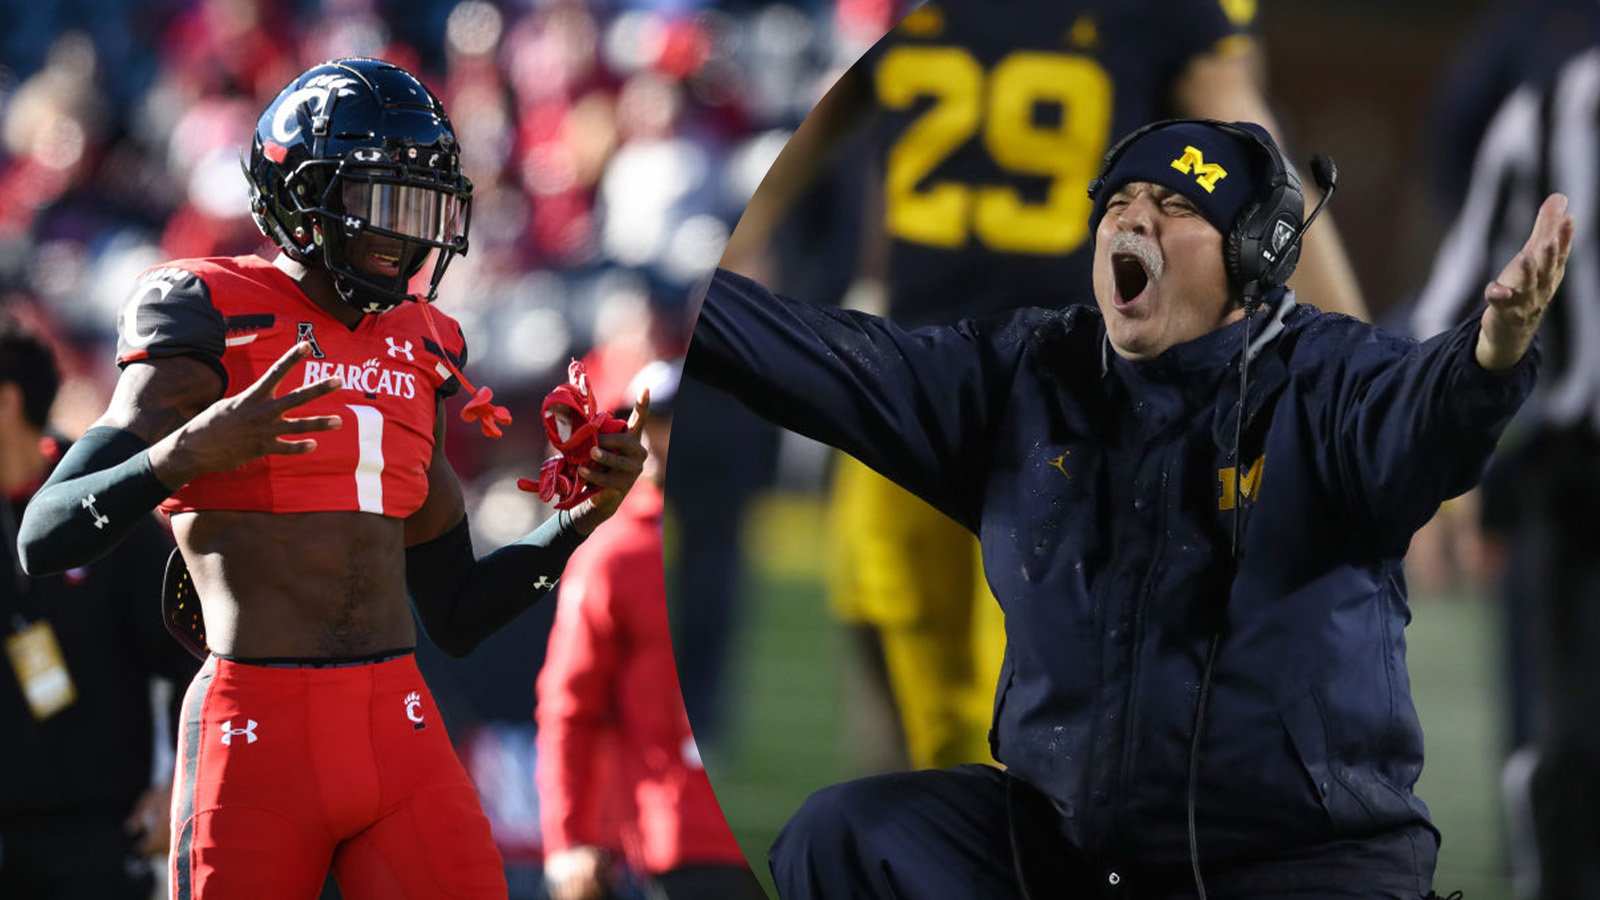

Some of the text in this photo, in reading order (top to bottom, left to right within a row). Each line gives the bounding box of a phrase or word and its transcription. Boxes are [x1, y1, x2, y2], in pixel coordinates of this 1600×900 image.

[875, 46, 1114, 254] 29
[1170, 145, 1228, 194] M
[303, 361, 415, 400] BEARCATS
[345, 403, 385, 515] 1
[1218, 454, 1266, 510] M
